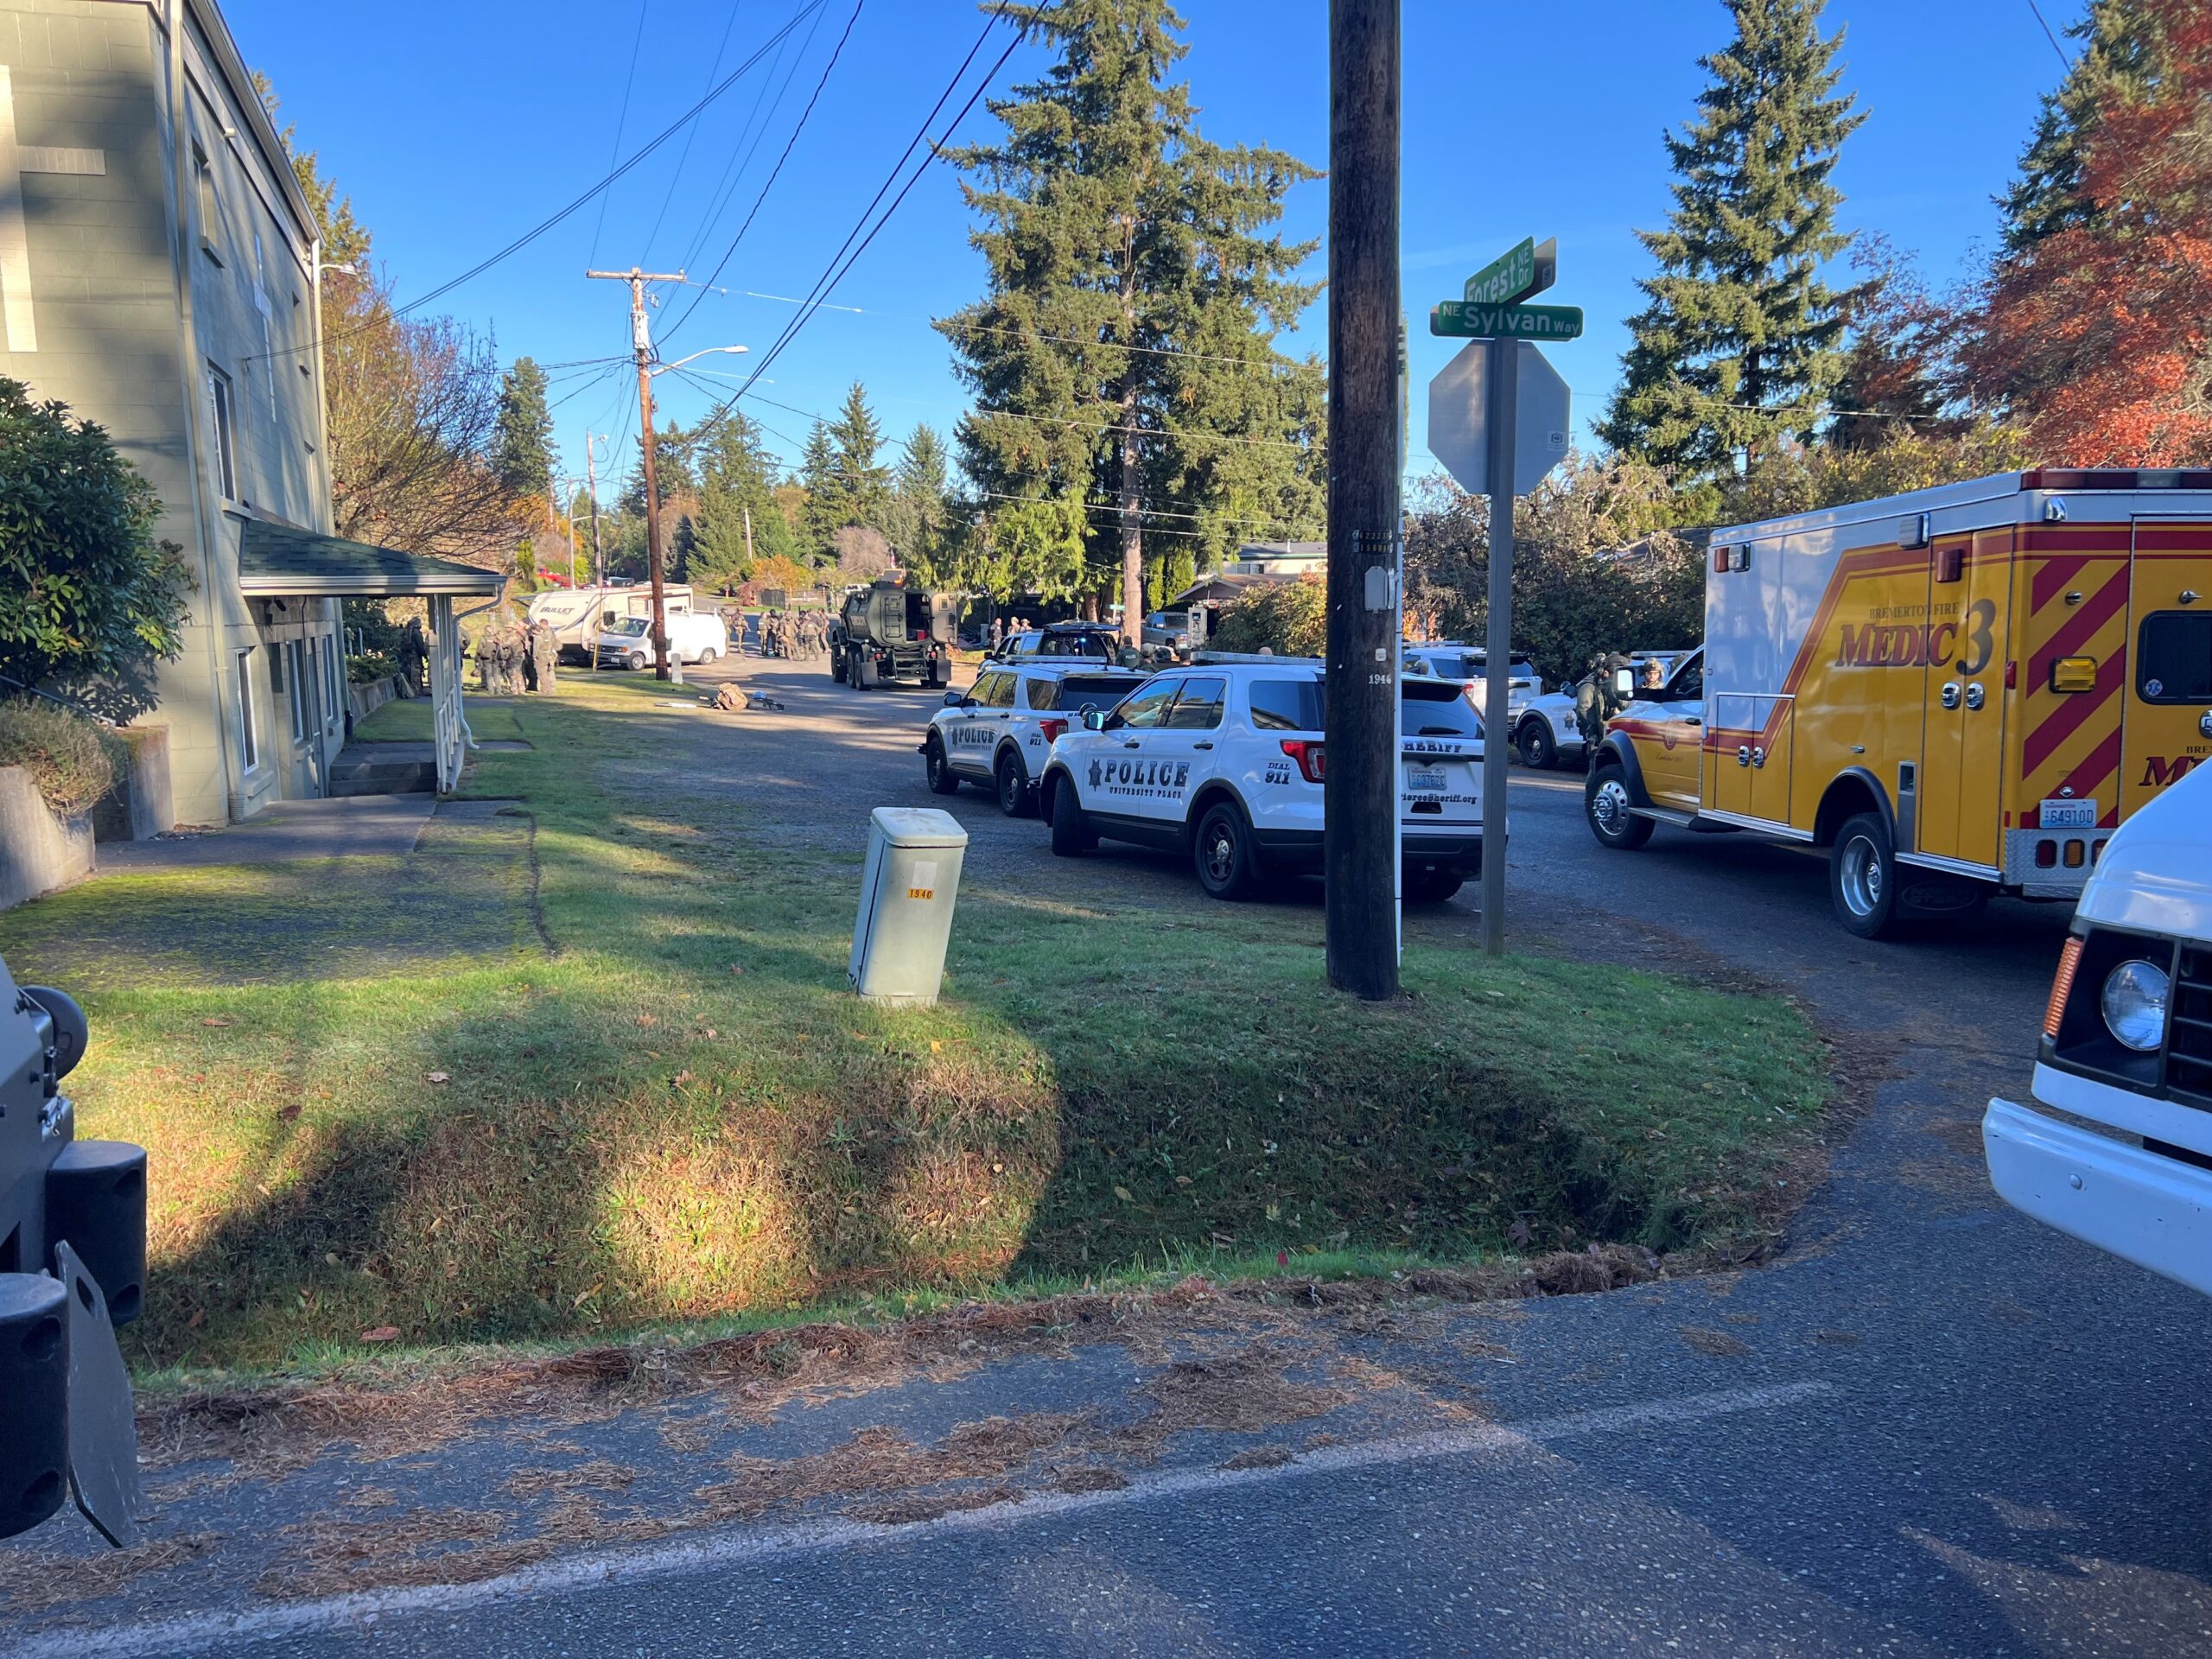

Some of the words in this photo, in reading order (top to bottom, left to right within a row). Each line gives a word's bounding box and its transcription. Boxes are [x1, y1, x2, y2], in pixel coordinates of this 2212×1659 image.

[1517, 245, 1529, 269] NE
[1466, 257, 1516, 302] Forest
[1518, 268, 1529, 286] Dr
[1442, 304, 1461, 317] NE
[1464, 305, 1550, 334] Sylvan
[1554, 320, 1580, 334] Way
[539, 607, 575, 615] BULLET
[1933, 602, 1960, 616] FIRE
[1834, 622, 1959, 667] MEDIC
[1955, 598, 1997, 677] 3
[958, 726, 995, 744] POLICE
[1401, 740, 1462, 753] HERIFF
[1104, 760, 1190, 787] POLICE
[1268, 762, 1291, 771] DIAL
[1264, 769, 1291, 785] 911
[1109, 786, 1154, 797] UNIVERSITY
[1157, 790, 1181, 798] PLACE
[2050, 810, 2094, 823] 64910D
[910, 889, 932, 899] 1940
